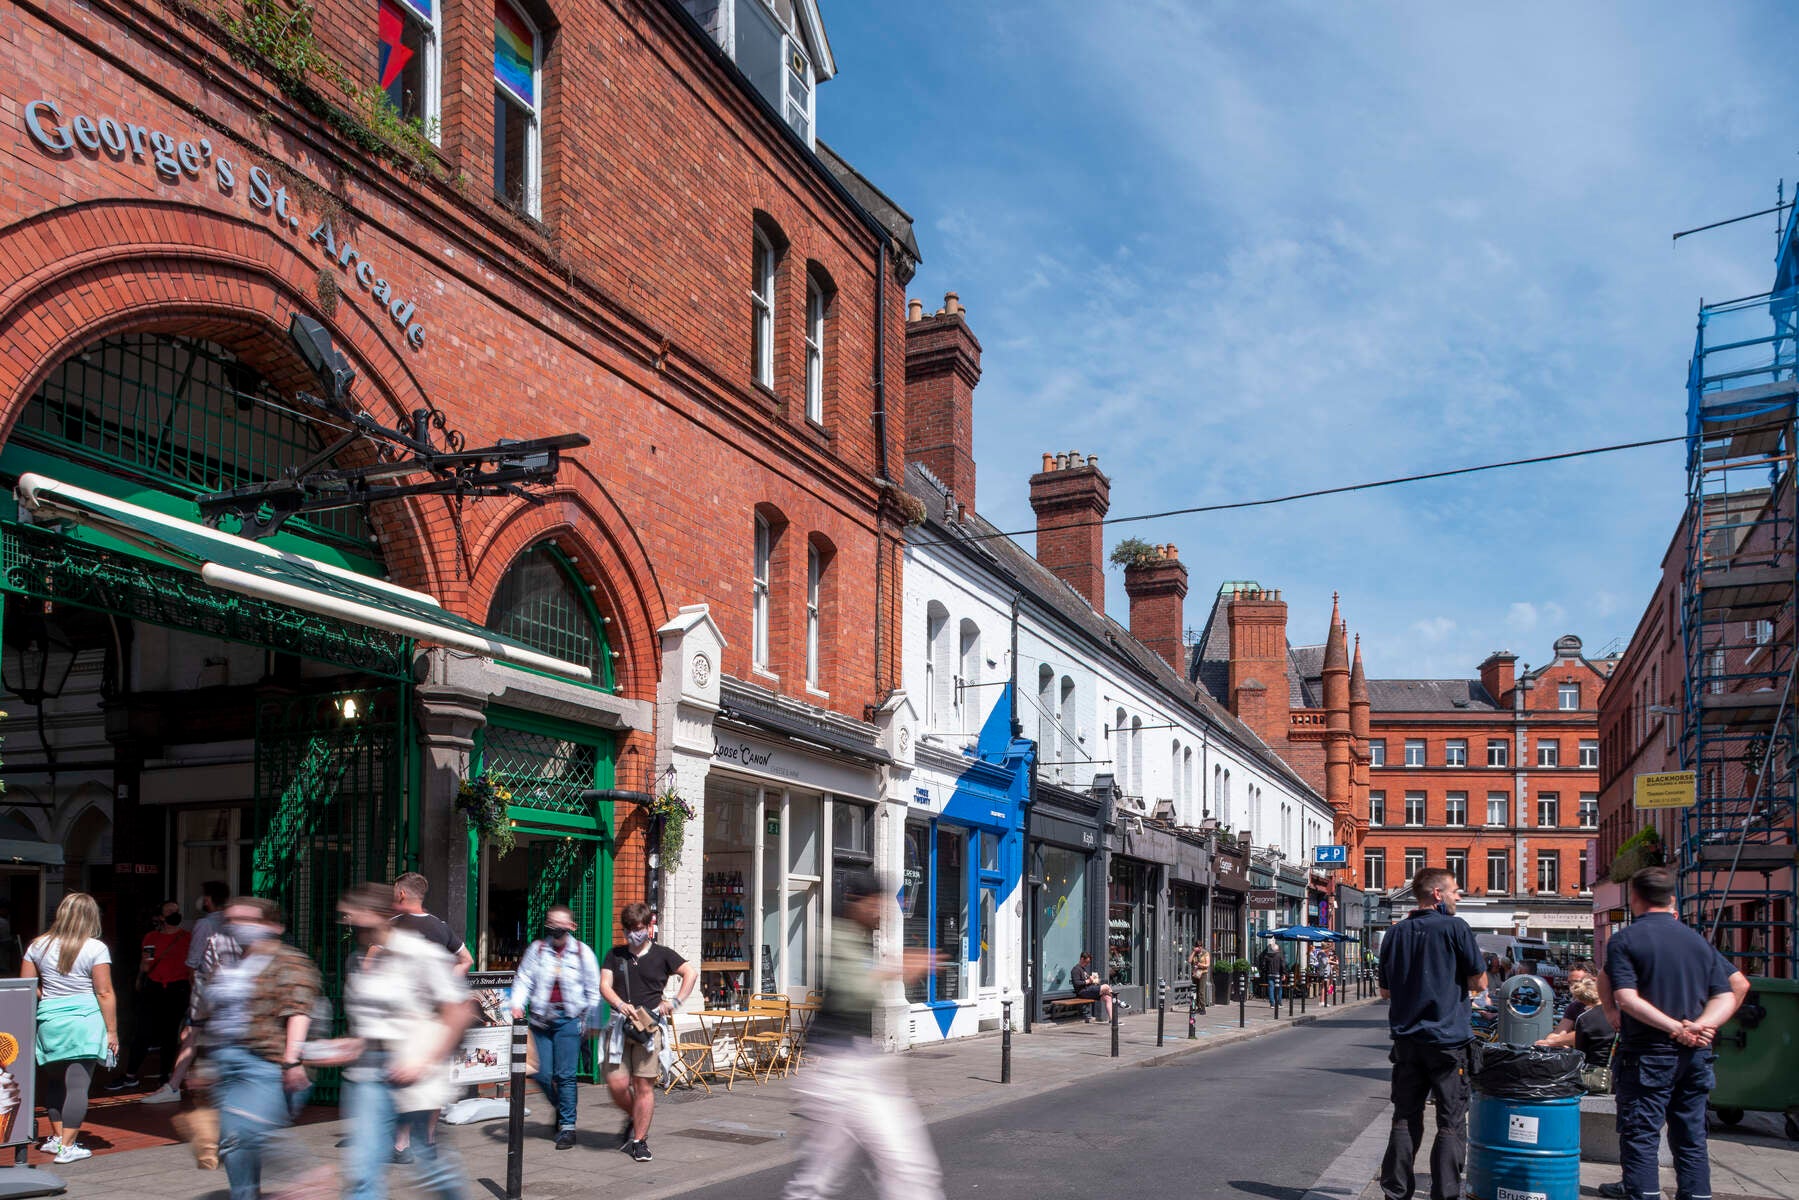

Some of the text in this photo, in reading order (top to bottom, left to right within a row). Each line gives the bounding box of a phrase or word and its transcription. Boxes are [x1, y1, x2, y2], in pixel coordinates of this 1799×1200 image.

[24, 99, 427, 349] George's St. Arcade
[1333, 848, 1340, 859] P
[480, 976, 496, 985] Street
